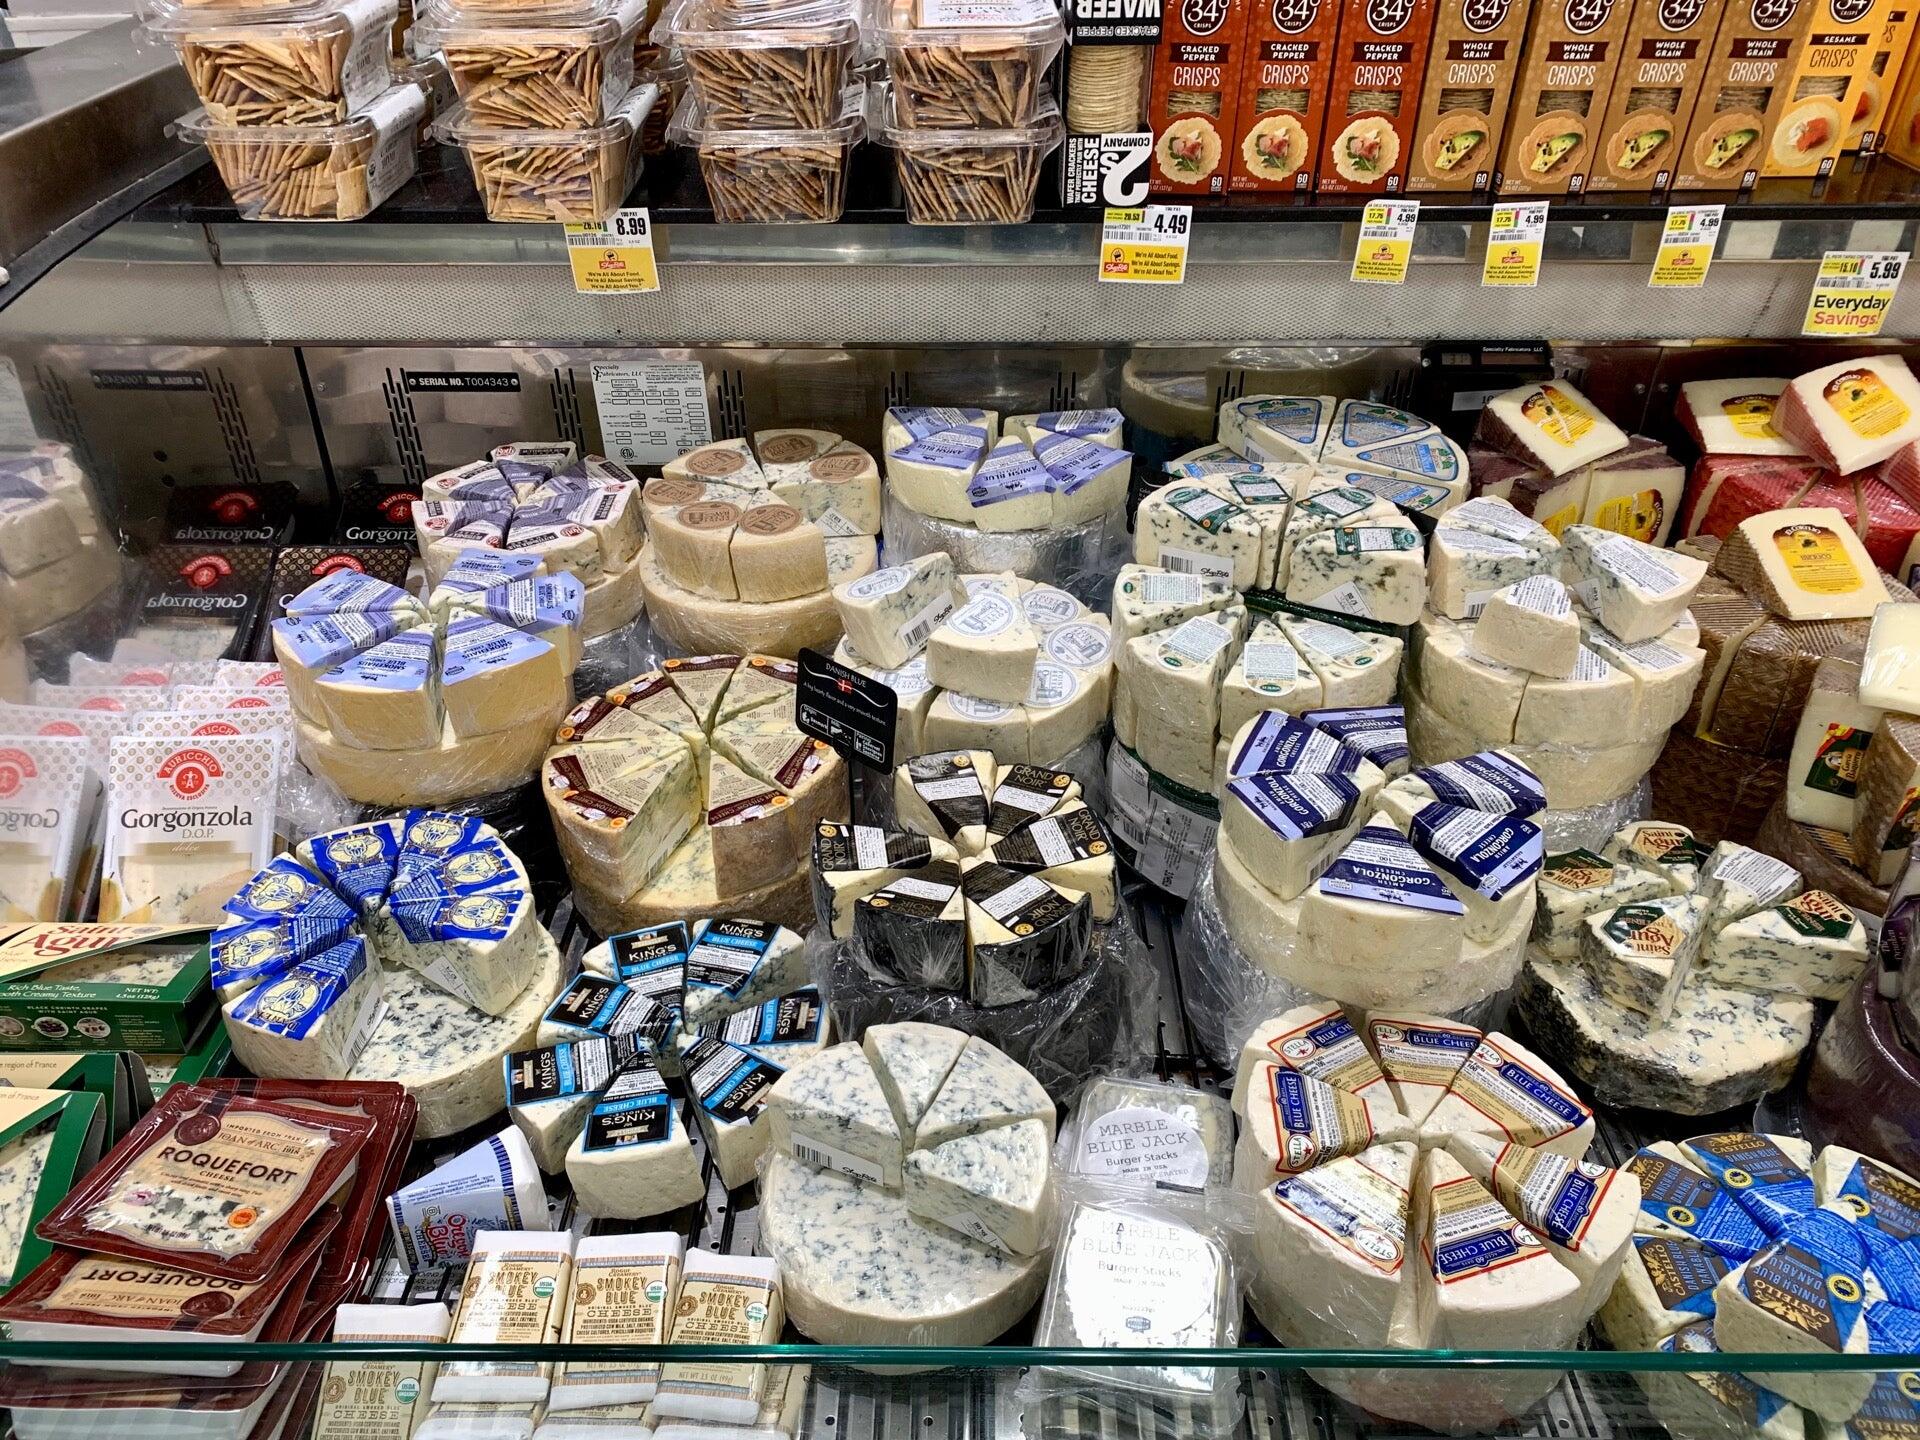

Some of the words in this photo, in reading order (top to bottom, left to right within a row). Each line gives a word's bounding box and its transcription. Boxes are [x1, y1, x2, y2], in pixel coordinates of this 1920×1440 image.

[1077, 26, 1113, 36] PEPPER
[1115, 26, 1159, 36] CRACKED
[1823, 35, 1857, 43] SESAME
[1181, 45, 1220, 54] CRACKED
[1270, 43, 1309, 51] CRACKED
[1364, 44, 1403, 53] CRACKED
[1462, 42, 1493, 50] WHOLE
[1563, 44, 1594, 52] WHOLE
[1655, 41, 1685, 50] WHOLE
[1655, 49, 1681, 57] GRAIN
[1746, 41, 1777, 49] WHOLE
[1747, 48, 1773, 57] GRAIN
[1183, 53, 1216, 62] PEPPER
[1273, 51, 1305, 59] PEPPER
[1366, 52, 1398, 60] PEPPER
[1463, 50, 1490, 58] GRAIN
[1563, 52, 1590, 60] GRAIN
[1810, 48, 1857, 69] CRISPS
[1173, 67, 1221, 88] CRISPS
[1262, 65, 1309, 85] CRISPS
[1355, 66, 1402, 86] CRISPS
[1448, 64, 1495, 84] CRISPS
[1548, 65, 1595, 86] CRISPS
[1639, 63, 1685, 83] CRISPS
[1729, 62, 1776, 83] CRISPS
[1103, 137, 1150, 147] COMPANY
[1068, 138, 1076, 174] CRACKERS
[1821, 159, 1832, 170] 60
[1082, 137, 1099, 203] CHEESE
[1067, 176, 1075, 204] WAFER
[1570, 176, 1582, 187] 60
[616, 218, 646, 235] 8.99
[1154, 214, 1188, 234] 4.49
[1397, 214, 1416, 223] 4.99
[1525, 215, 1544, 224] 4.99
[1700, 218, 1719, 227] 4.99
[1870, 262, 1901, 279] 5.99
[1814, 294, 1890, 312] Everyday
[1814, 311, 1881, 328] Savings!
[419, 377, 448, 387] SERIAL
[449, 378, 464, 387] NO.
[465, 377, 509, 388] T004343
[984, 471, 1006, 482] BLUE
[1009, 465, 1038, 479] AMISH
[825, 663, 850, 680] DANISH
[850, 675, 867, 688] BLUE
[1341, 720, 1401, 730] GORGONZOLA
[1276, 731, 1303, 768] GORGONZOLA
[164, 751, 217, 773] AURICCHIO
[1014, 765, 1054, 781] GRAND
[1465, 759, 1521, 795] GORGONZOLA
[1265, 776, 1310, 815] GORGONZOLA
[121, 805, 253, 832] Gorgonzola
[1078, 808, 1101, 840] GRAND
[182, 829, 214, 839] D.O.P.
[1643, 829, 1674, 839] Saint
[1469, 827, 1514, 863] GORGONZOLA
[1642, 836, 1684, 852] Agur
[822, 838, 834, 870] GRAND
[1353, 865, 1431, 886] GORGONZOLA
[719, 922, 764, 938] KING'S
[9, 932, 135, 957] Agur
[711, 935, 730, 944] BLUE
[731, 937, 757, 948] CHEESE
[1627, 929, 1674, 950] Agur
[629, 944, 677, 961] KING'S
[1635, 942, 1670, 957] Saint
[631, 961, 654, 973] BLUE
[656, 955, 679, 968] CHEESE
[8, 984, 29, 992] Rich
[31, 984, 52, 992] Blue
[54, 984, 81, 992] Taste,
[21, 991, 59, 1000] Creamy
[61, 991, 97, 999] Texture
[579, 986, 610, 1019] KING'S
[783, 998, 795, 1035] KING'S
[1284, 1039, 1310, 1056] STELLA
[1413, 1035, 1438, 1046] BLUE
[35, 1060, 57, 1069] France
[541, 1052, 552, 1090] KING'S
[724, 1072, 766, 1110] KING'S
[1286, 1076, 1301, 1105] CHEESE
[1504, 1068, 1531, 1089] BLUE
[1529, 1084, 1571, 1117] CHEESE
[603, 1101, 635, 1112] CHEESE
[635, 1097, 657, 1107] BLUE
[601, 1111, 656, 1126] KING'S
[1294, 1106, 1305, 1128] BLUE
[1099, 1119, 1168, 1137] MARBLE
[217, 1131, 246, 1146] JOAN
[254, 1139, 278, 1151] ARC
[1087, 1138, 1136, 1155] BLUE
[1142, 1132, 1190, 1148] JACK
[1711, 1141, 1766, 1154] CASTELLO
[281, 1145, 300, 1155] 1918
[1291, 1137, 1301, 1166] STELLA
[157, 1145, 298, 1186] ROQUEFORT
[1105, 1154, 1142, 1168] Burger
[1144, 1151, 1178, 1162] Stacks
[1742, 1159, 1783, 1173] DANABLU
[199, 1169, 235, 1183] CHEESE
[1566, 1178, 1586, 1200] BLUE
[1551, 1199, 1574, 1230] CHEESE
[1481, 1235, 1509, 1252] BLUE
[1438, 1242, 1478, 1266] CHEESE
[1655, 1244, 1686, 1296] CASTELLO
[1753, 1265, 1782, 1285] BLUE
[1769, 1256, 1822, 1291] DANABLU
[81, 1268, 247, 1291] ROQUEFORT
[597, 1277, 647, 1291] SMOKEY
[605, 1291, 637, 1305] BLUE
[700, 1292, 749, 1307] SMOKEY
[1753, 1279, 1831, 1324] CASTELLO
[1782, 1277, 1828, 1310] DANISH
[587, 1308, 651, 1318] CHEESE
[705, 1307, 737, 1321] BLUE
[685, 1321, 749, 1333] CHEESE
[348, 1371, 400, 1388] SMOKEY
[354, 1388, 387, 1404] BLUE
[333, 1410, 399, 1420] CHEESE
